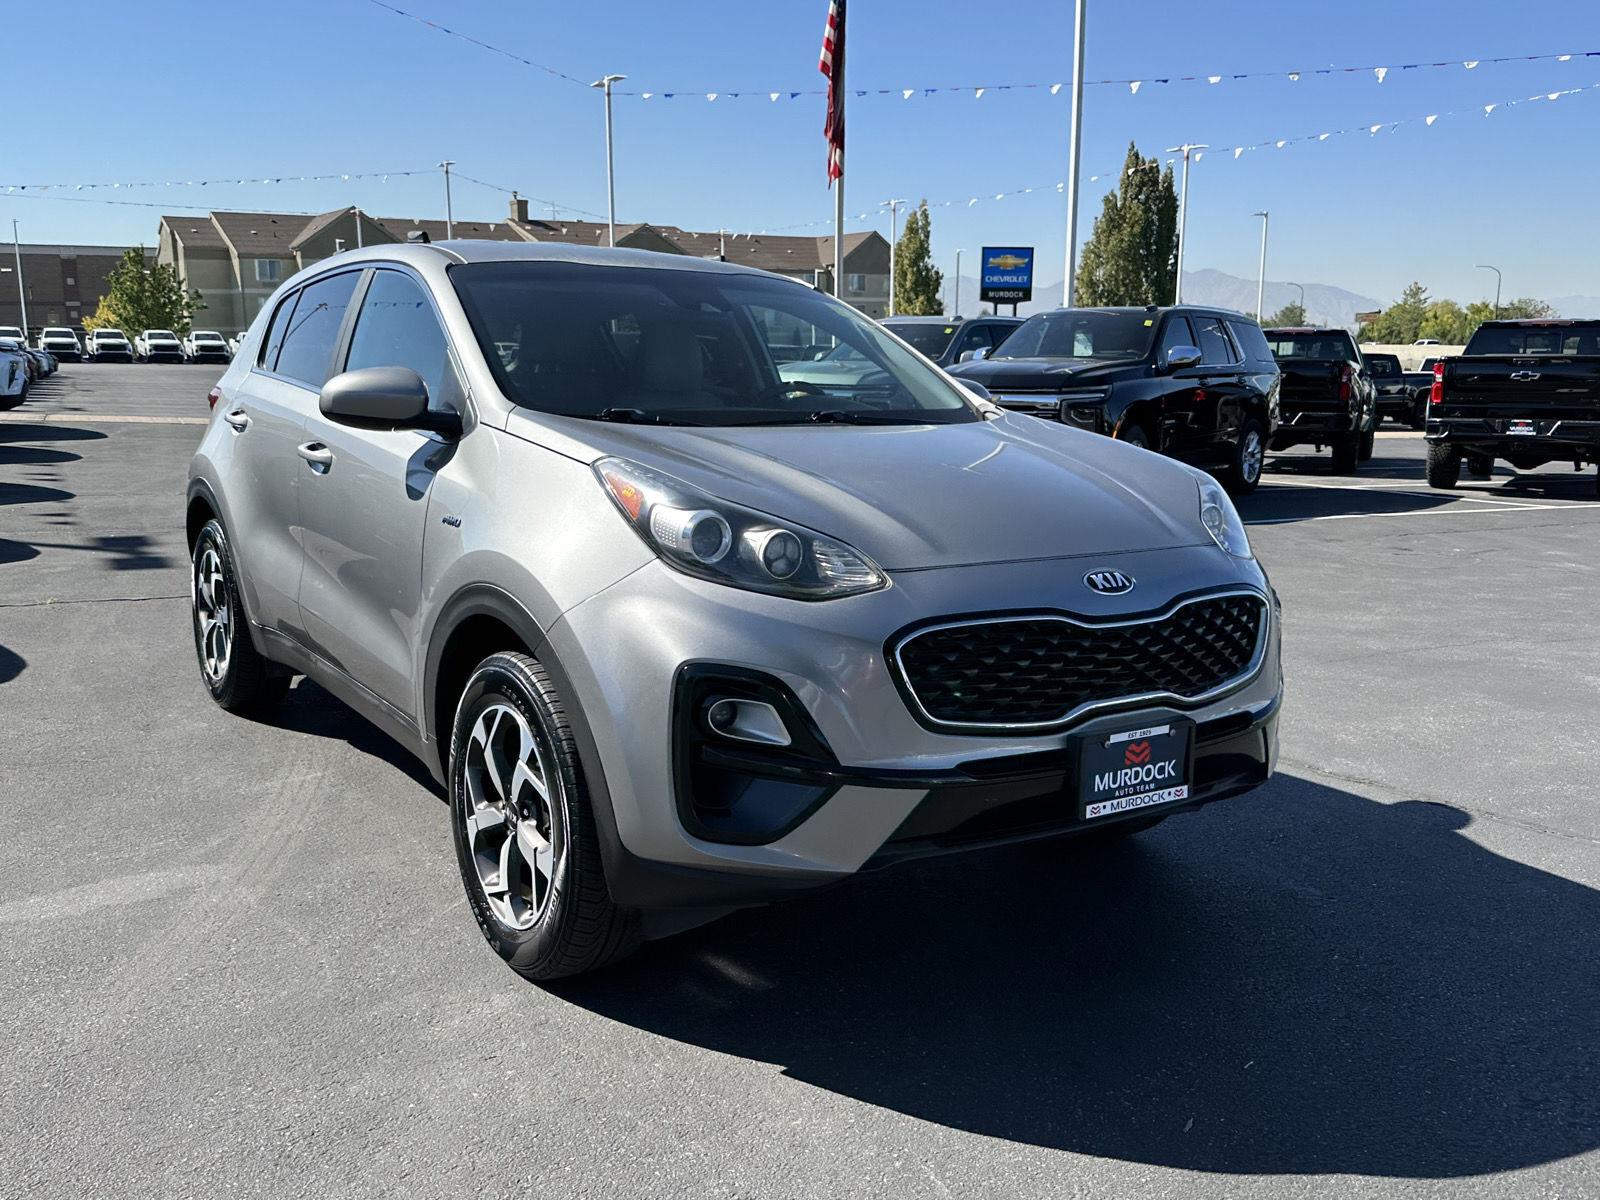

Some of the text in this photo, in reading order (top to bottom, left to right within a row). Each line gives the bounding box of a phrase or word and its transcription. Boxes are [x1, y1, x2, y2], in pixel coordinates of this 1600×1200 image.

[985, 275, 1028, 283] CHEVROLET
[1090, 572, 1130, 589] KIA
[1094, 760, 1176, 792] MURDOCK
[1115, 783, 1155, 797] AUTO TEAM
[1110, 791, 1166, 812] MURDOCK
